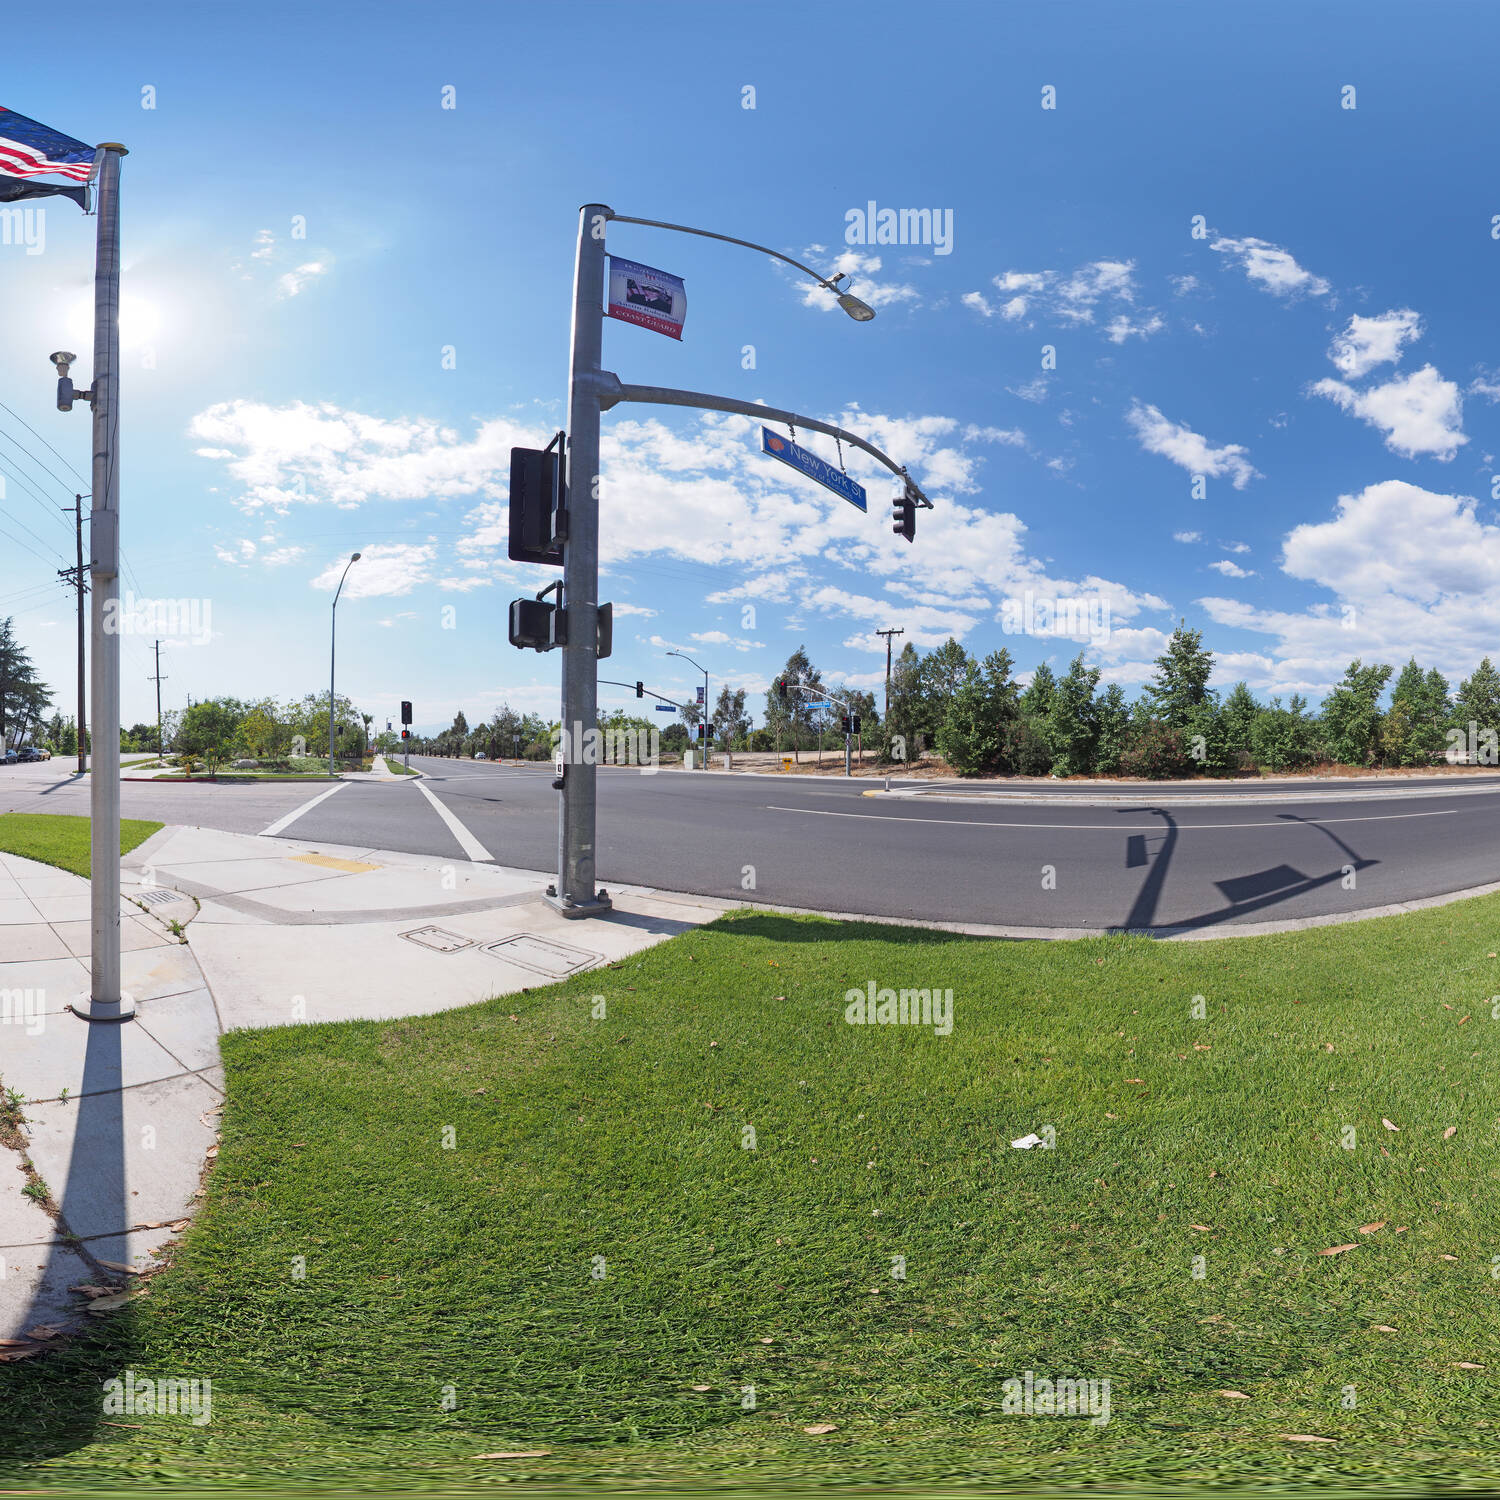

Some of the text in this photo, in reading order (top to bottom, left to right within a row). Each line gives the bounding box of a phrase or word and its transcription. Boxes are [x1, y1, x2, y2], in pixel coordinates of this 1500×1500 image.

[615, 310, 677, 333] COAST GUARD
[790, 443, 862, 499] New York St
